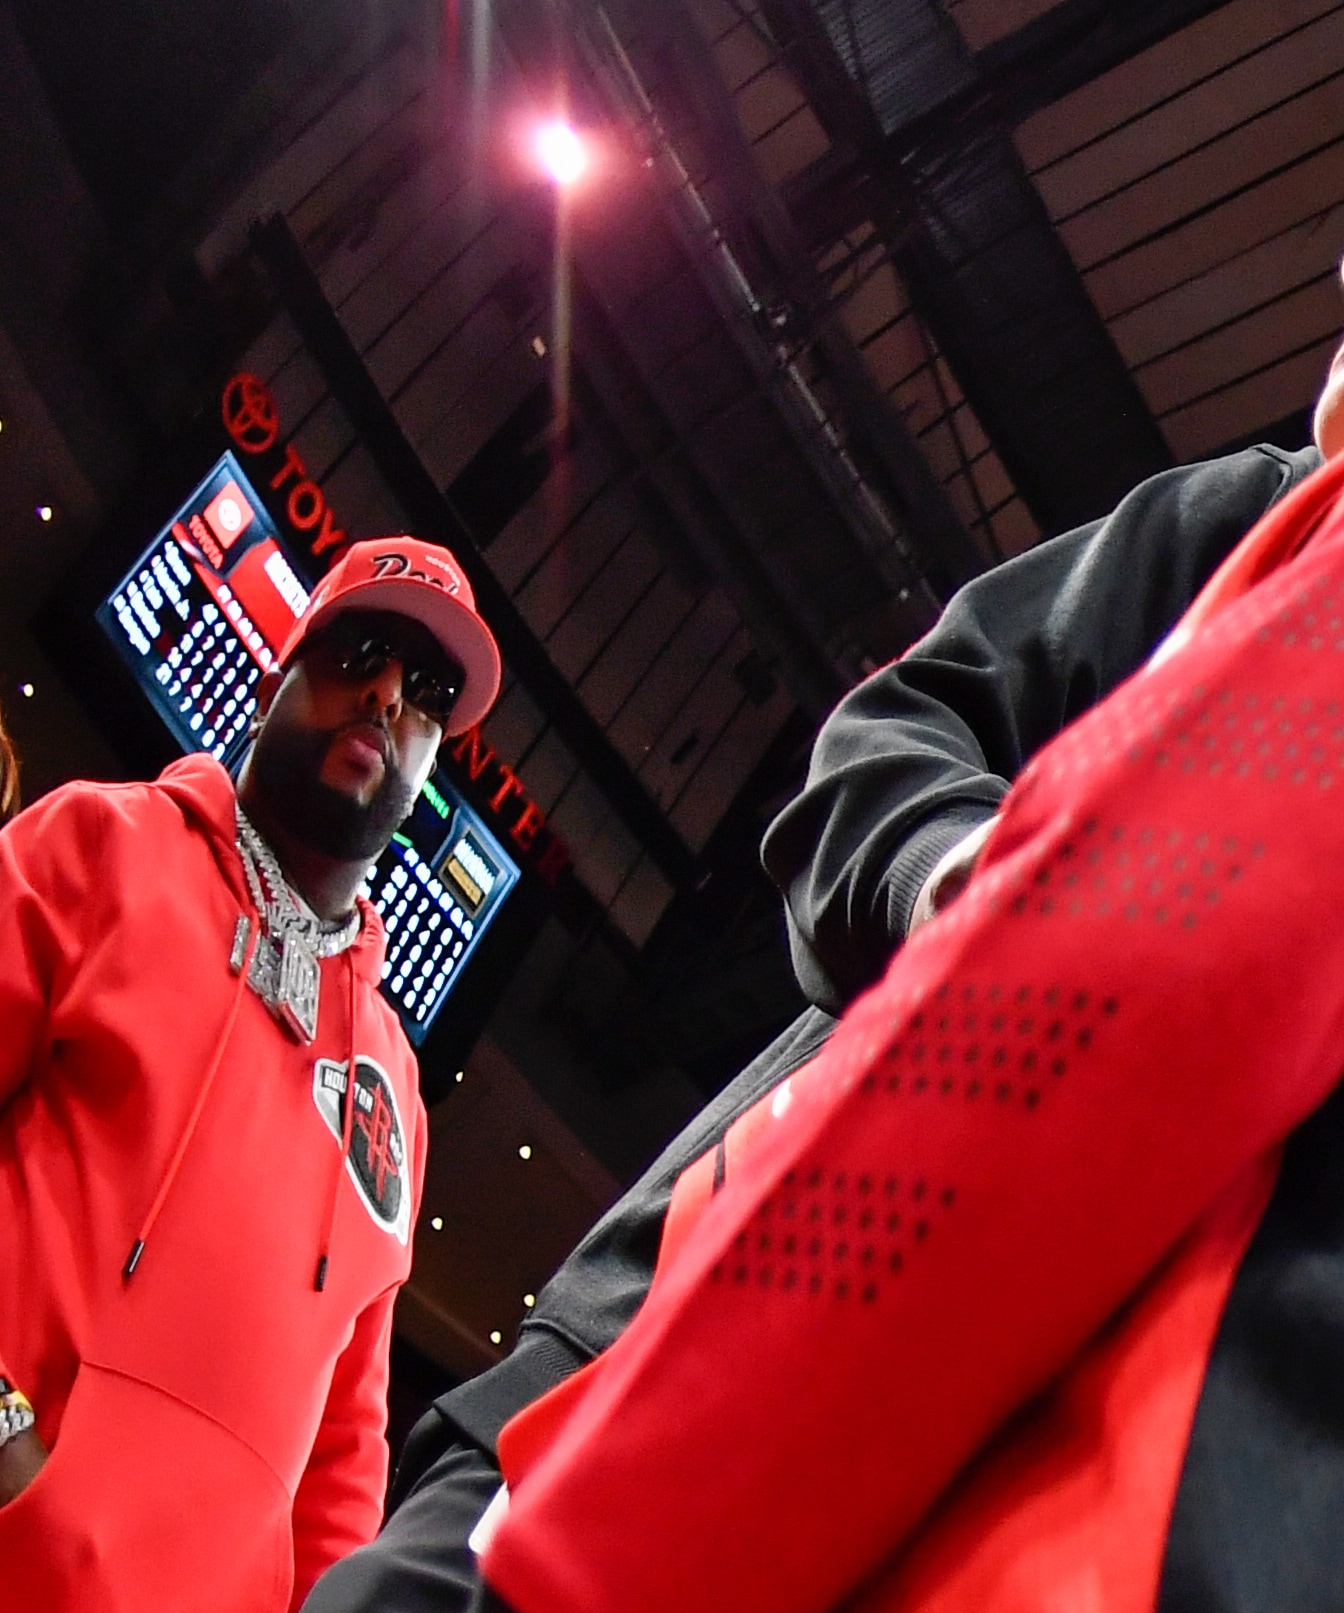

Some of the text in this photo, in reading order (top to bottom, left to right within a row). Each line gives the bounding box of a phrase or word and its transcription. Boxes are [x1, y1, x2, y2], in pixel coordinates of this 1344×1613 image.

[269, 443, 347, 568] TOY
[451, 721, 575, 884] NTER
[323, 1066, 374, 1113] HOUTON
